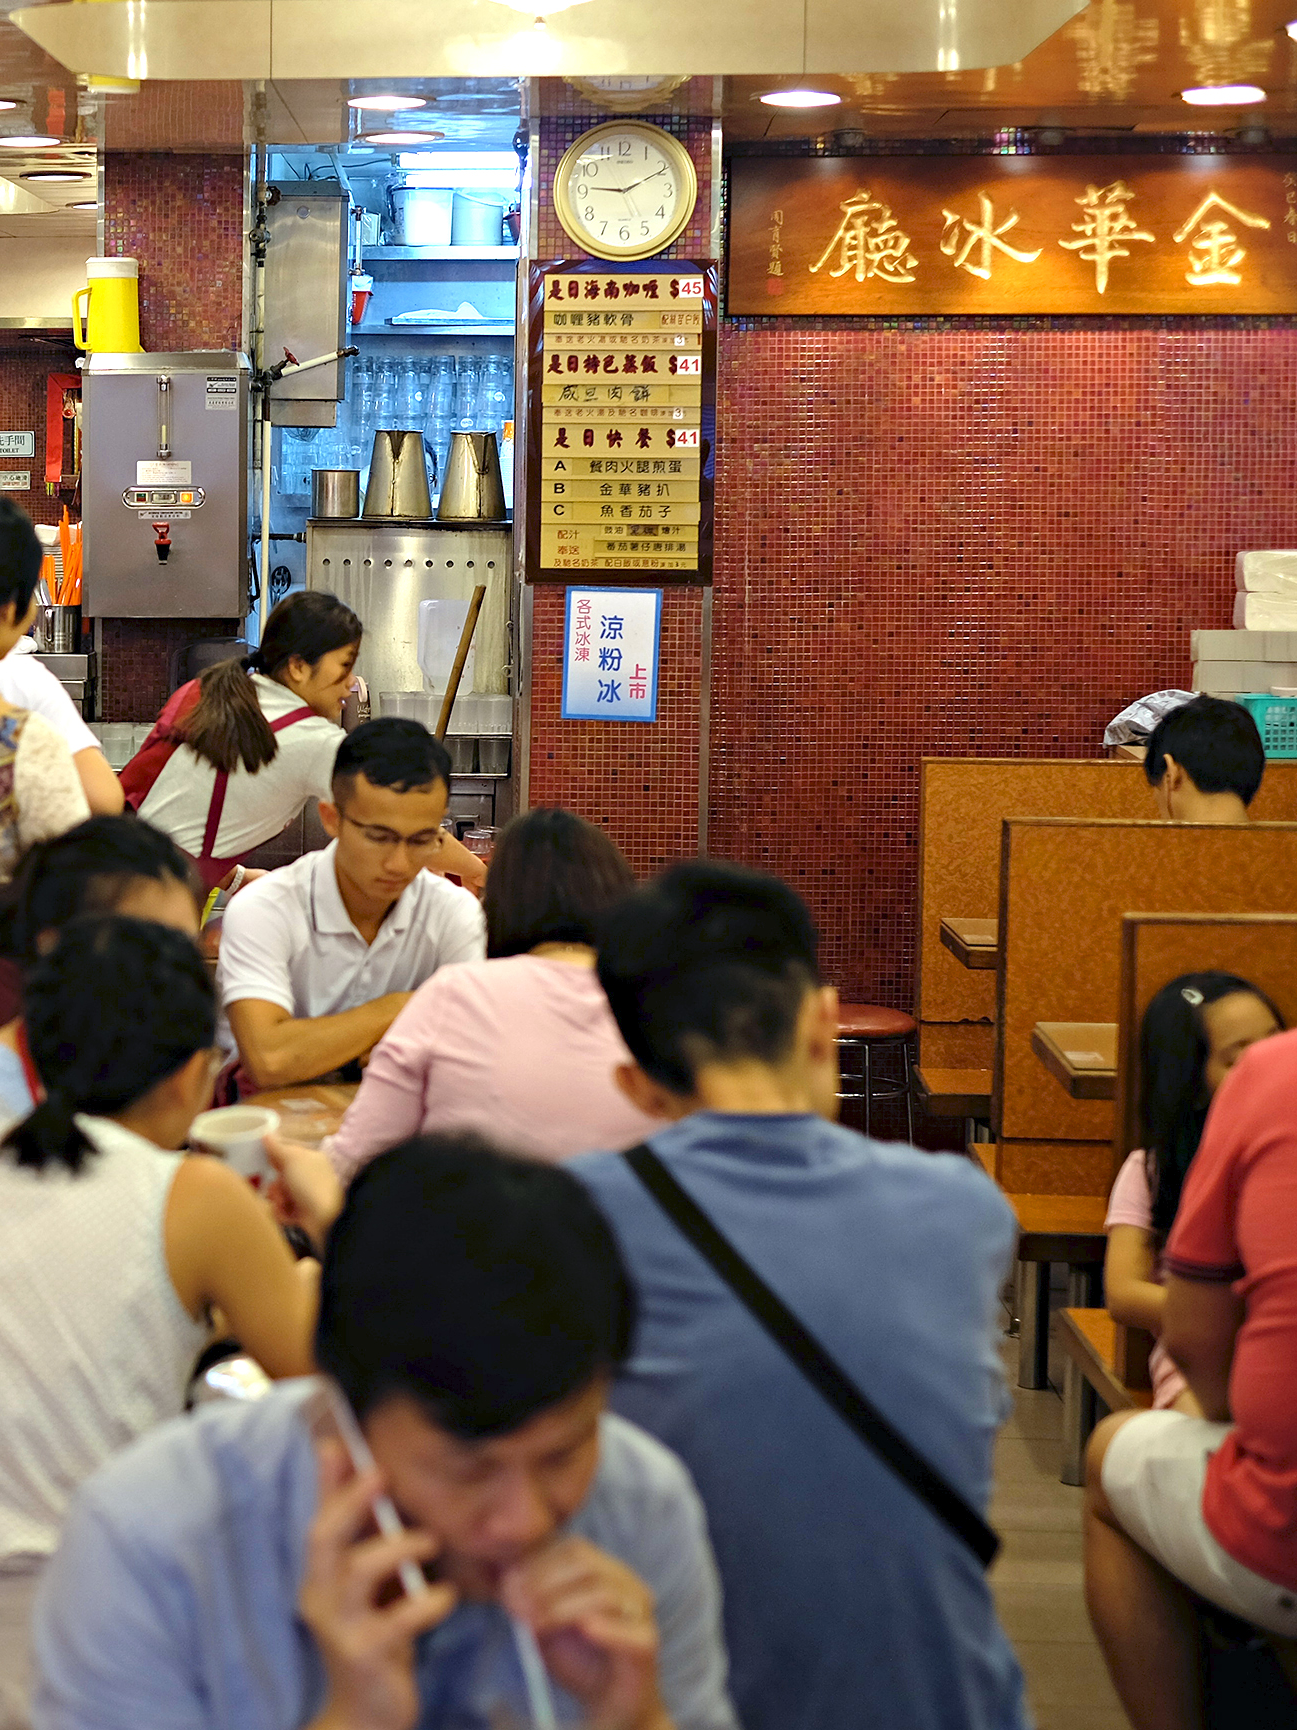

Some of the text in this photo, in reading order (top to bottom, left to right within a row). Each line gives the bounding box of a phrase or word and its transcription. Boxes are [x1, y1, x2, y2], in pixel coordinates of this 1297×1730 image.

[619, 141, 632, 157] 12
[582, 162, 598, 177] 10
[577, 184, 589, 199] 9
[663, 182, 673, 198] 3
[585, 205, 595, 221] 8
[655, 205, 665, 219] 4
[600, 220, 608, 236] 7
[619, 225, 630, 241] 6
[640, 221, 650, 236] 5
[669, 279, 702, 300] $45
[668, 355, 699, 375] $41
[554, 427, 697, 449] 是日快餐 $41
[554, 460, 682, 474] A 餐肉火腿煎蛋
[554, 483, 670, 497] B 金華豬扒
[553, 504, 672, 518] C 魚香茄子
[557, 530, 580, 540] 配汁
[557, 545, 580, 555] 奉送
[597, 614, 624, 704] 涼粉冰
[629, 663, 647, 700] 上市
